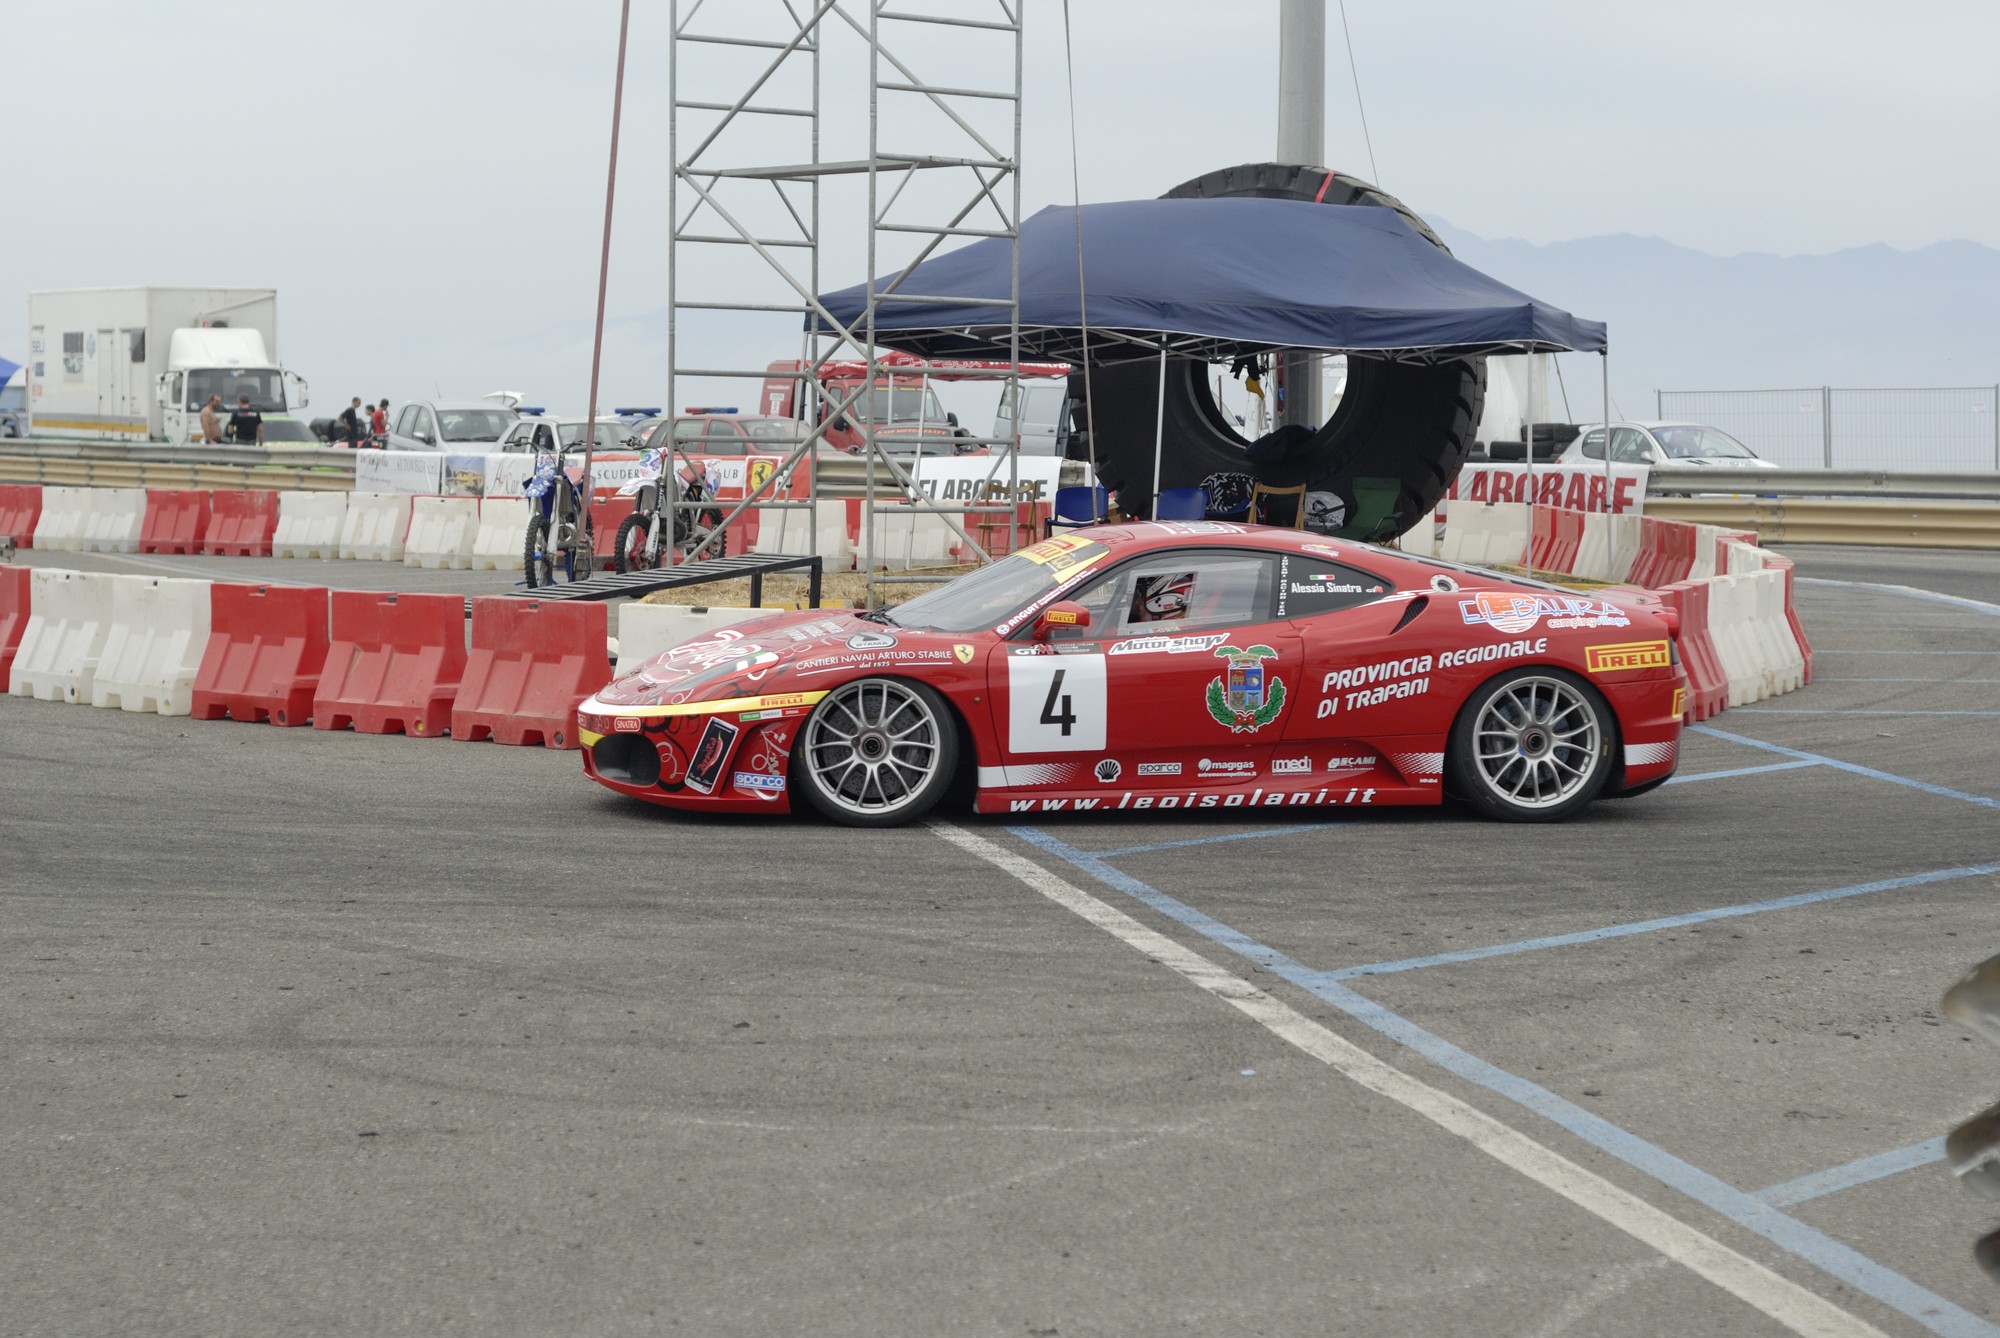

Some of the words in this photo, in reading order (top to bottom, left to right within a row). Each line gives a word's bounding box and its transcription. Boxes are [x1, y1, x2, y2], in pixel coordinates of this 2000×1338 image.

[597, 467, 640, 480] SCUDER
[1436, 470, 1638, 520] ABORARE
[1291, 582, 1326, 594] Alessia
[1326, 582, 1363, 594] Sinatra
[1047, 612, 1075, 623] PIRELLI
[1110, 639, 1171, 654] Motor
[1171, 633, 1229, 650] show
[795, 656, 839, 670] CANTIERI
[841, 652, 875, 663] NAVALI
[877, 651, 916, 660] ARTURO
[918, 650, 952, 659] STABILE
[1589, 643, 1668, 671] PIRELLI
[760, 694, 804, 707] PIRELLI
[1039, 668, 1077, 737] 4
[1316, 697, 1339, 720] DI
[616, 720, 638, 729] SINATRA
[1139, 763, 1181, 775] sparco
[1211, 760, 1255, 771] magigas
[1275, 755, 1309, 771] med
[735, 774, 784, 789] sparco
[1009, 787, 1378, 813] www.leoisolani.it
